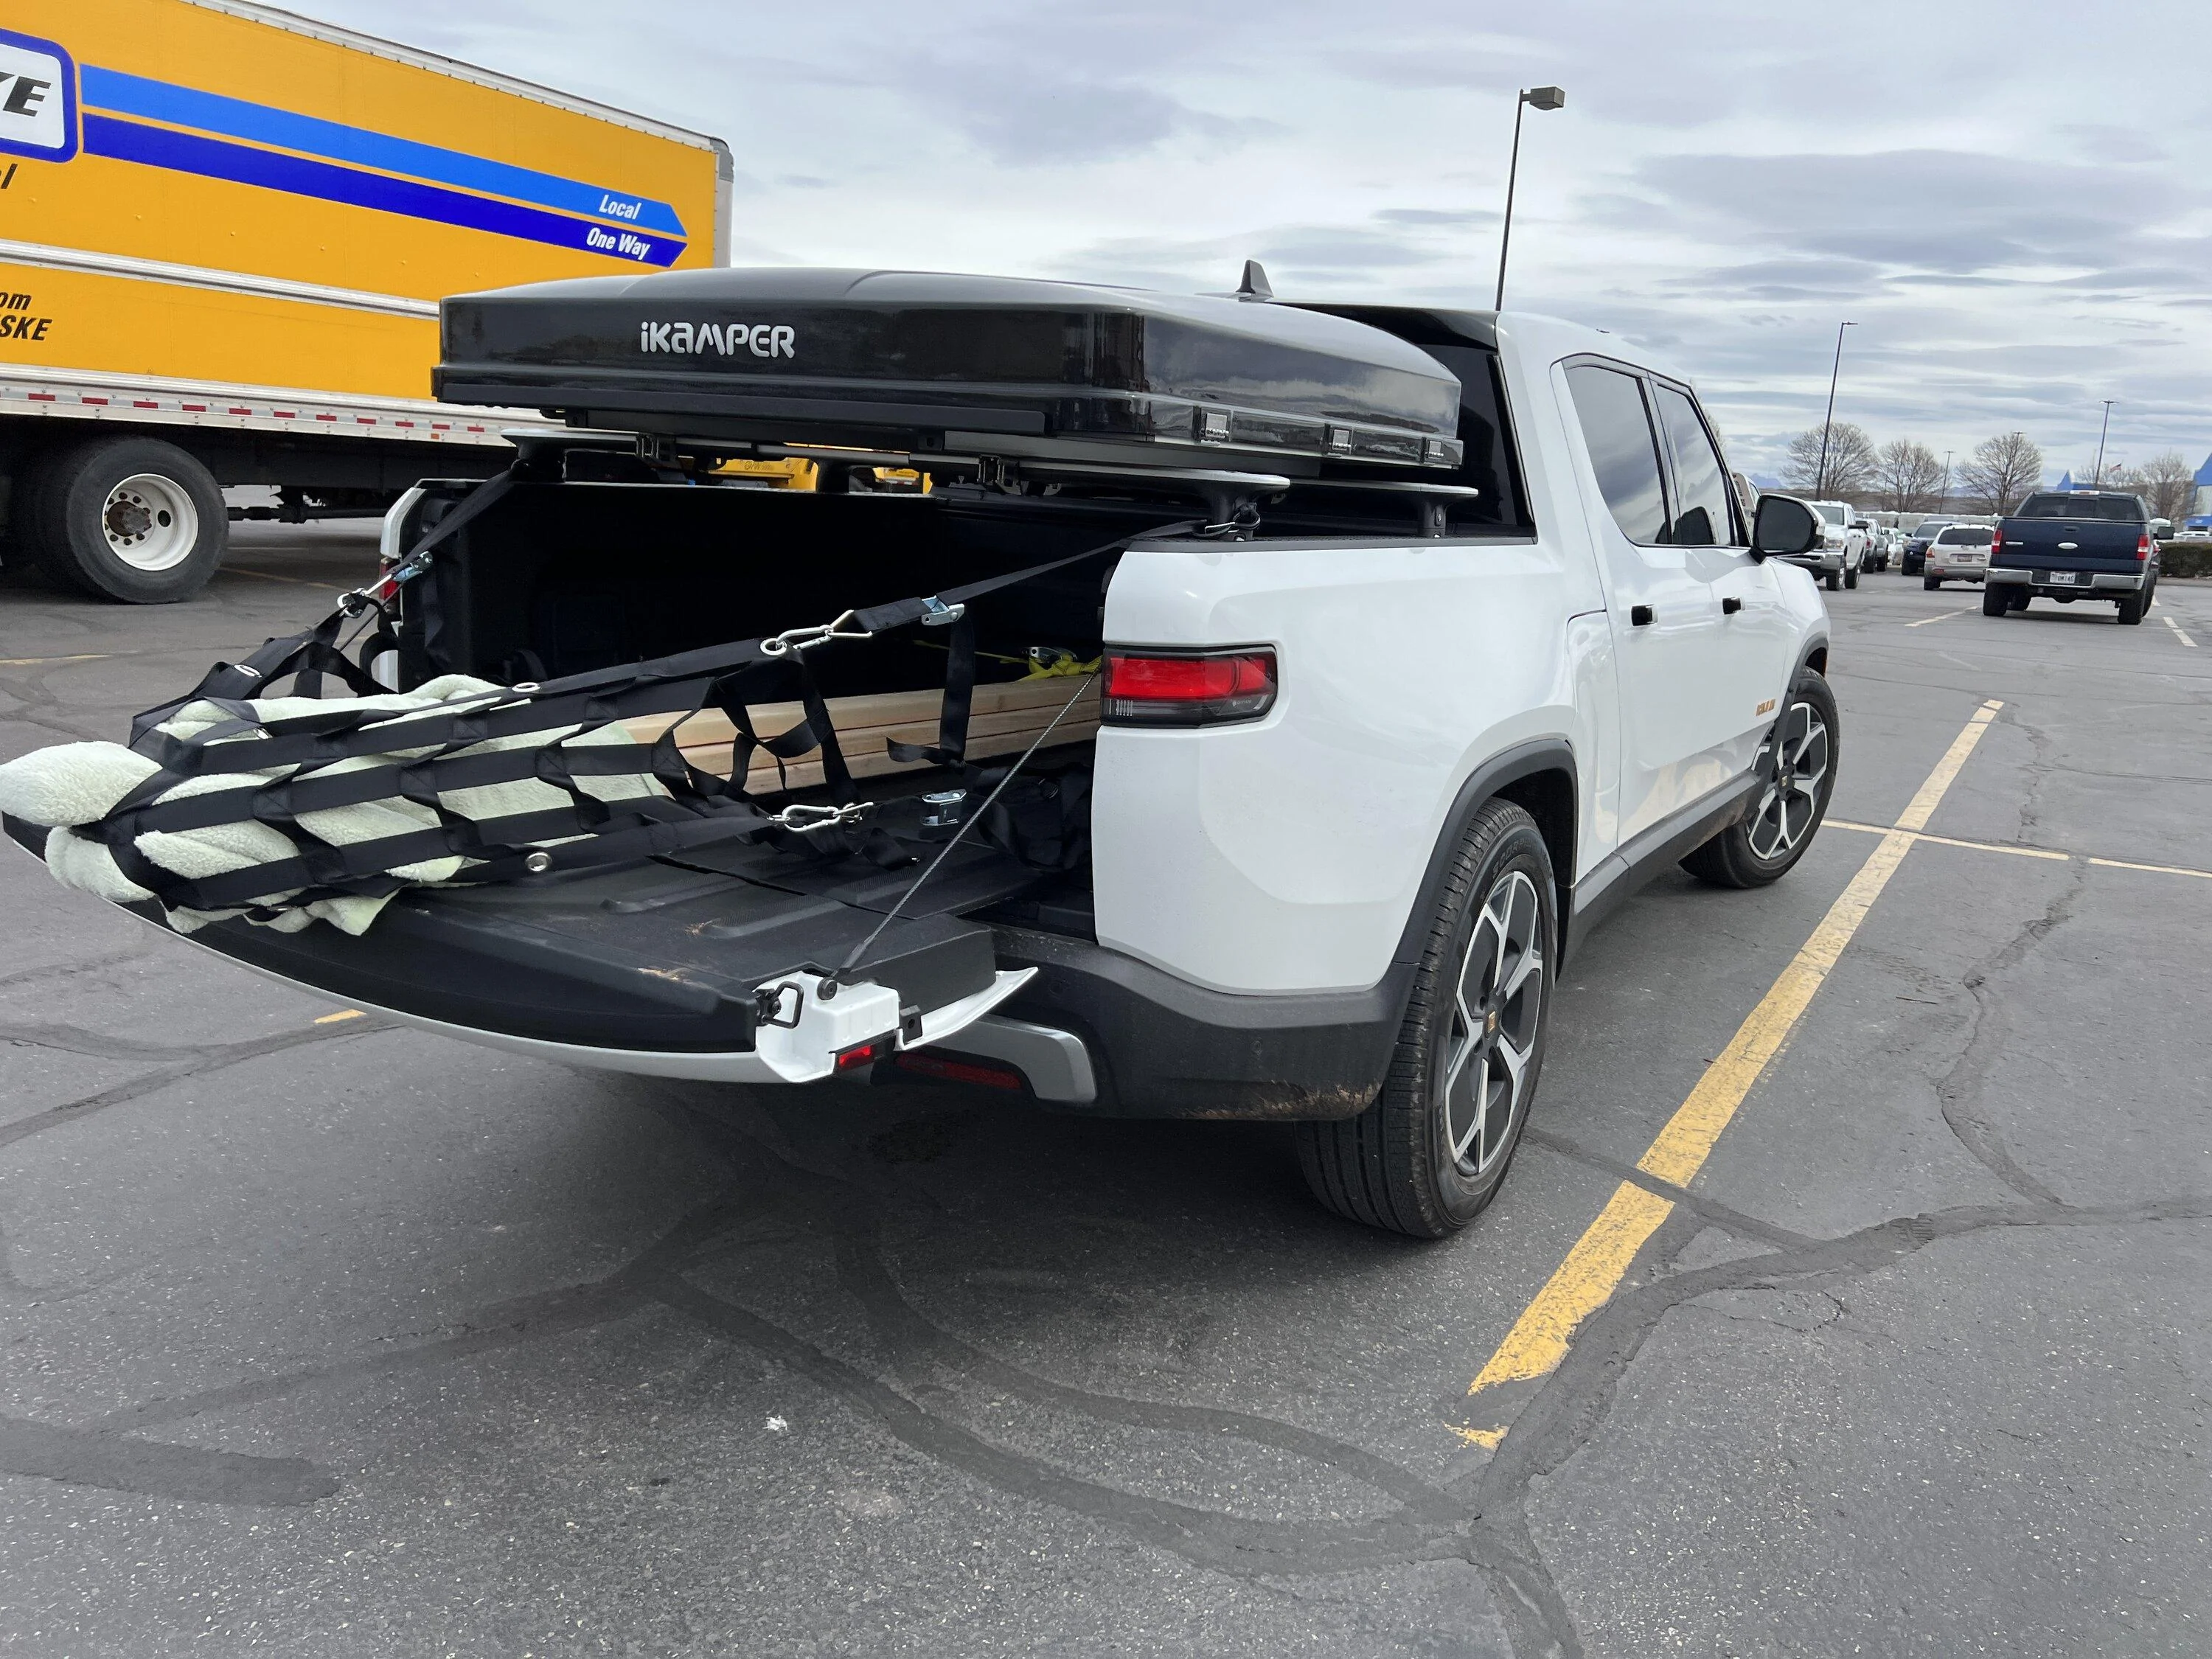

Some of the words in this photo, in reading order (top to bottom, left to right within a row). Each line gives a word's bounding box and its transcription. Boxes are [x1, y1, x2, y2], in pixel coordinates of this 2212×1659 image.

[598, 194, 642, 220] Local
[586, 227, 616, 250] One
[618, 233, 651, 261] Way
